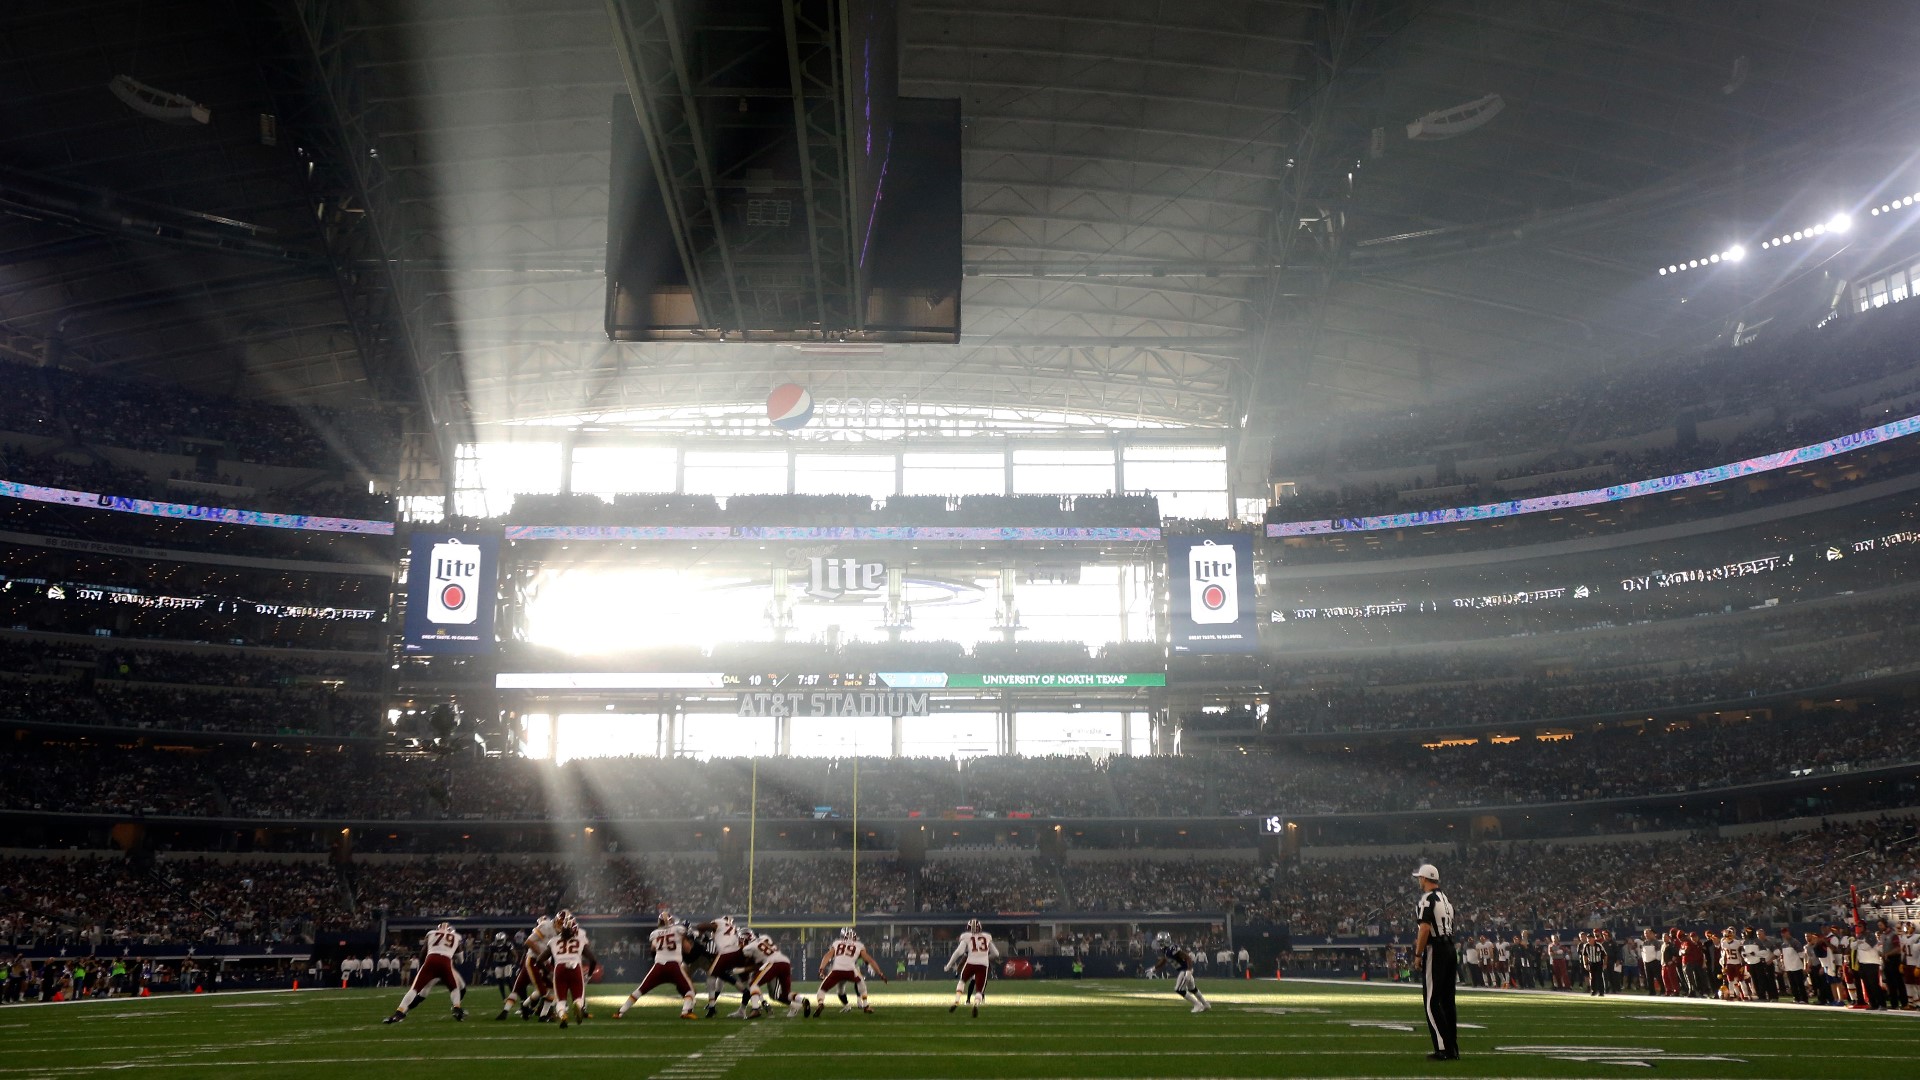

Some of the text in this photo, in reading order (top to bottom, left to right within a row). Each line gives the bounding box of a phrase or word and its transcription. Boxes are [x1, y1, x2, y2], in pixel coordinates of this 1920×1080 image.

[823, 394, 907, 425] pepsi
[61, 540, 88, 550] DREW
[91, 542, 134, 555] PEARSON
[435, 558, 476, 581] Lite
[807, 557, 884, 599] Lite
[1195, 561, 1232, 582] Lite
[723, 675, 741, 684] DAL
[982, 674, 1125, 685] UNIVERSITY OF NORTH TEXAS
[738, 692, 929, 717] AT&T STADIUM
[1266, 816, 1282, 833] 15
[431, 932, 455, 949] 79
[556, 939, 580, 956] 32
[655, 933, 677, 952] 75
[970, 936, 988, 952] 13
[836, 943, 857, 958] 89
